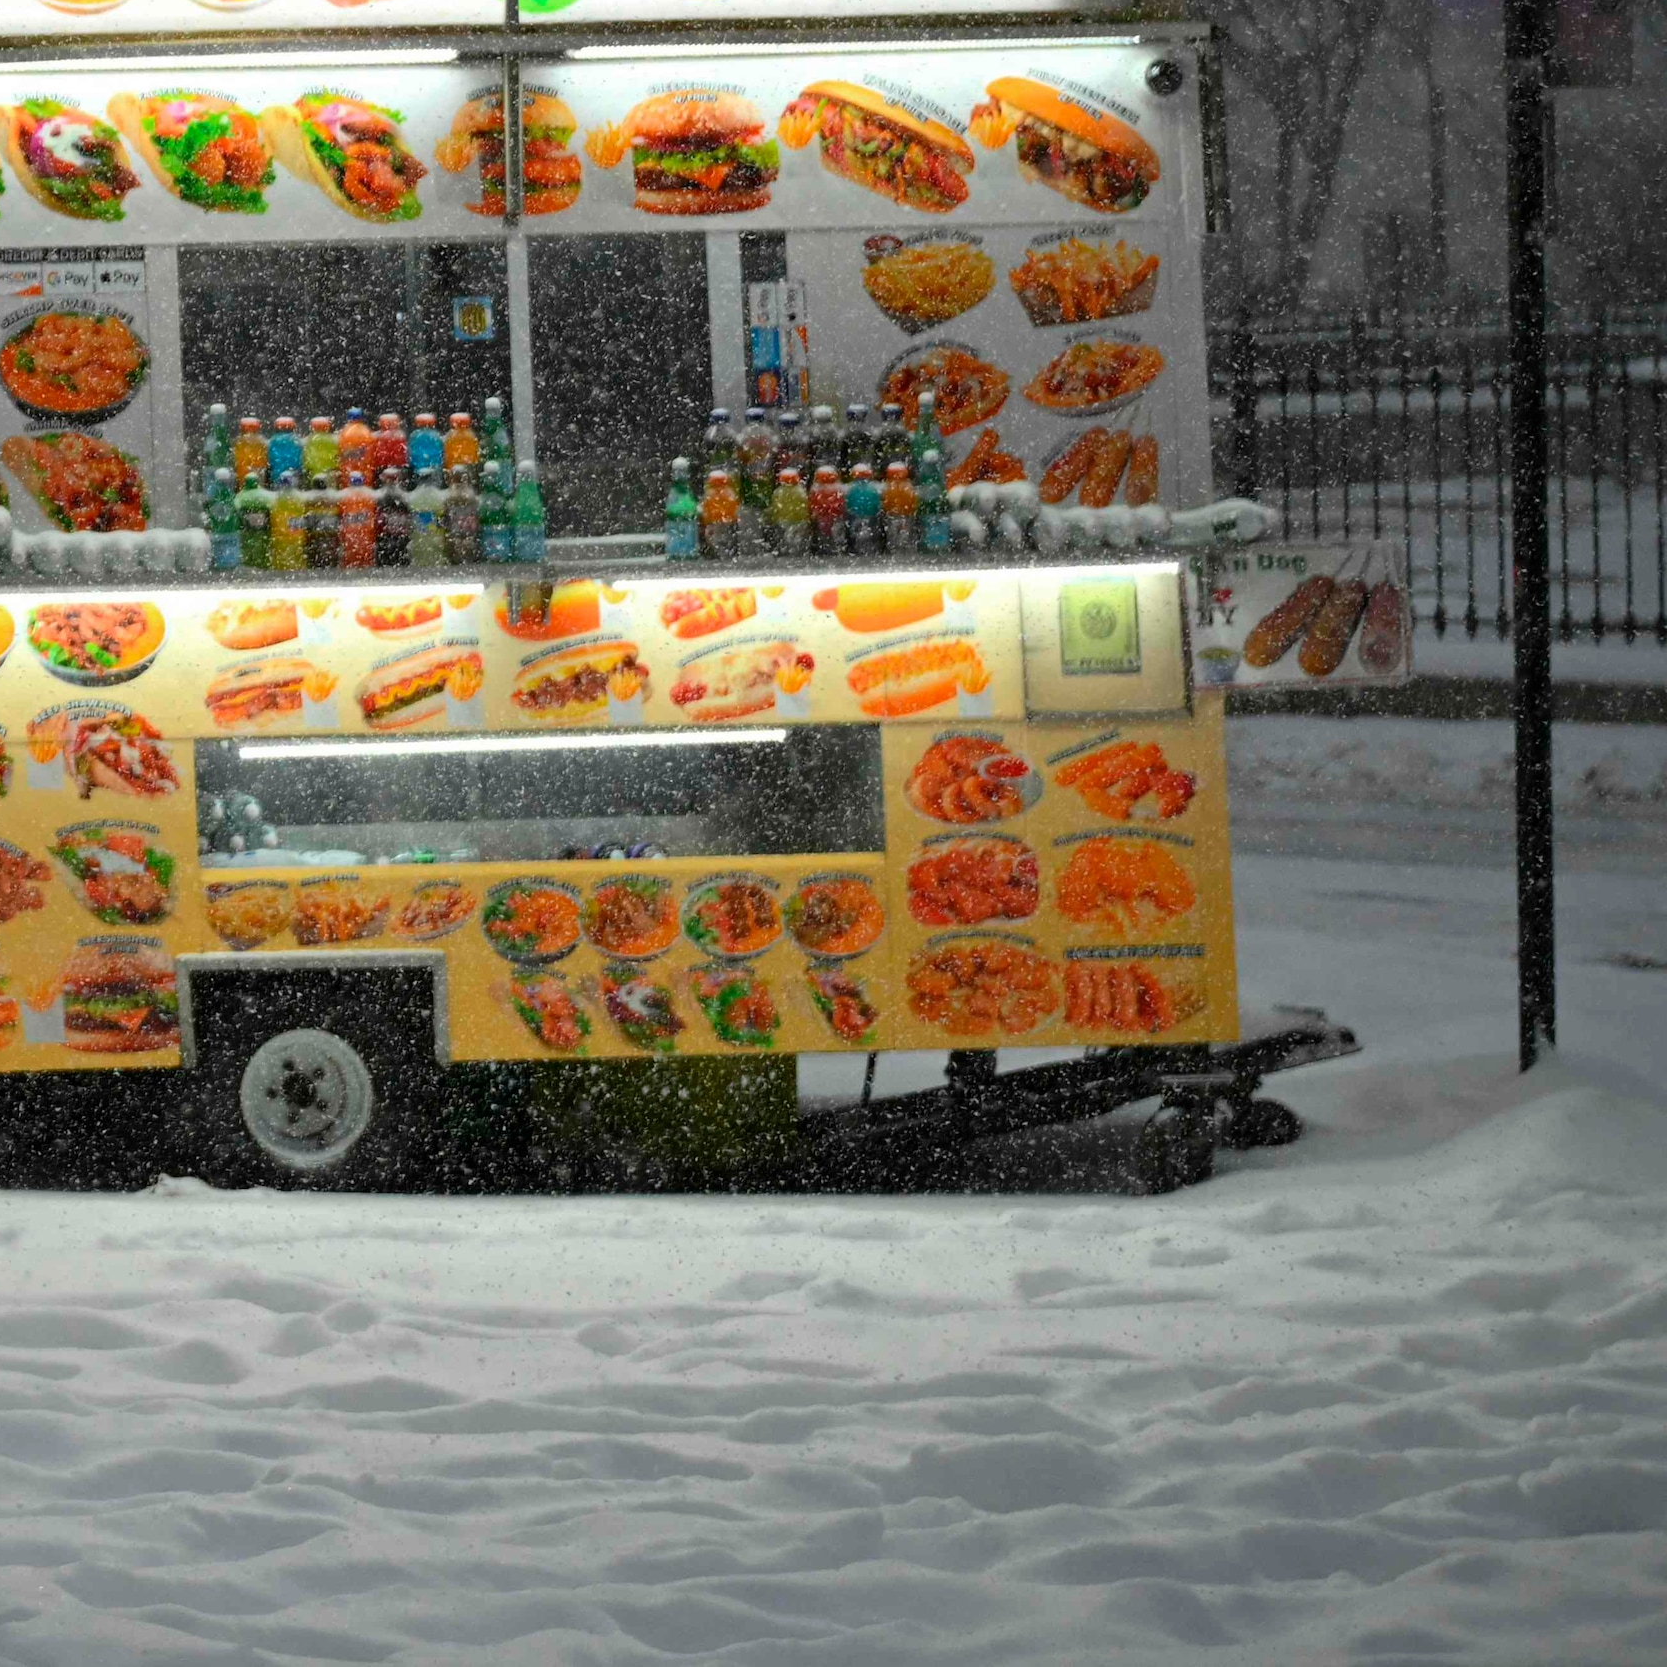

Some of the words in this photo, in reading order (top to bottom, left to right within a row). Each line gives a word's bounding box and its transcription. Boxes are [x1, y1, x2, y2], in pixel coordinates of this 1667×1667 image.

[65, 272, 88, 287] Pay
[112, 271, 140, 286] Pay
[1256, 553, 1307, 574] Dog
[33, 704, 62, 724] BEEF
[66, 699, 133, 717] SHAWARMA
